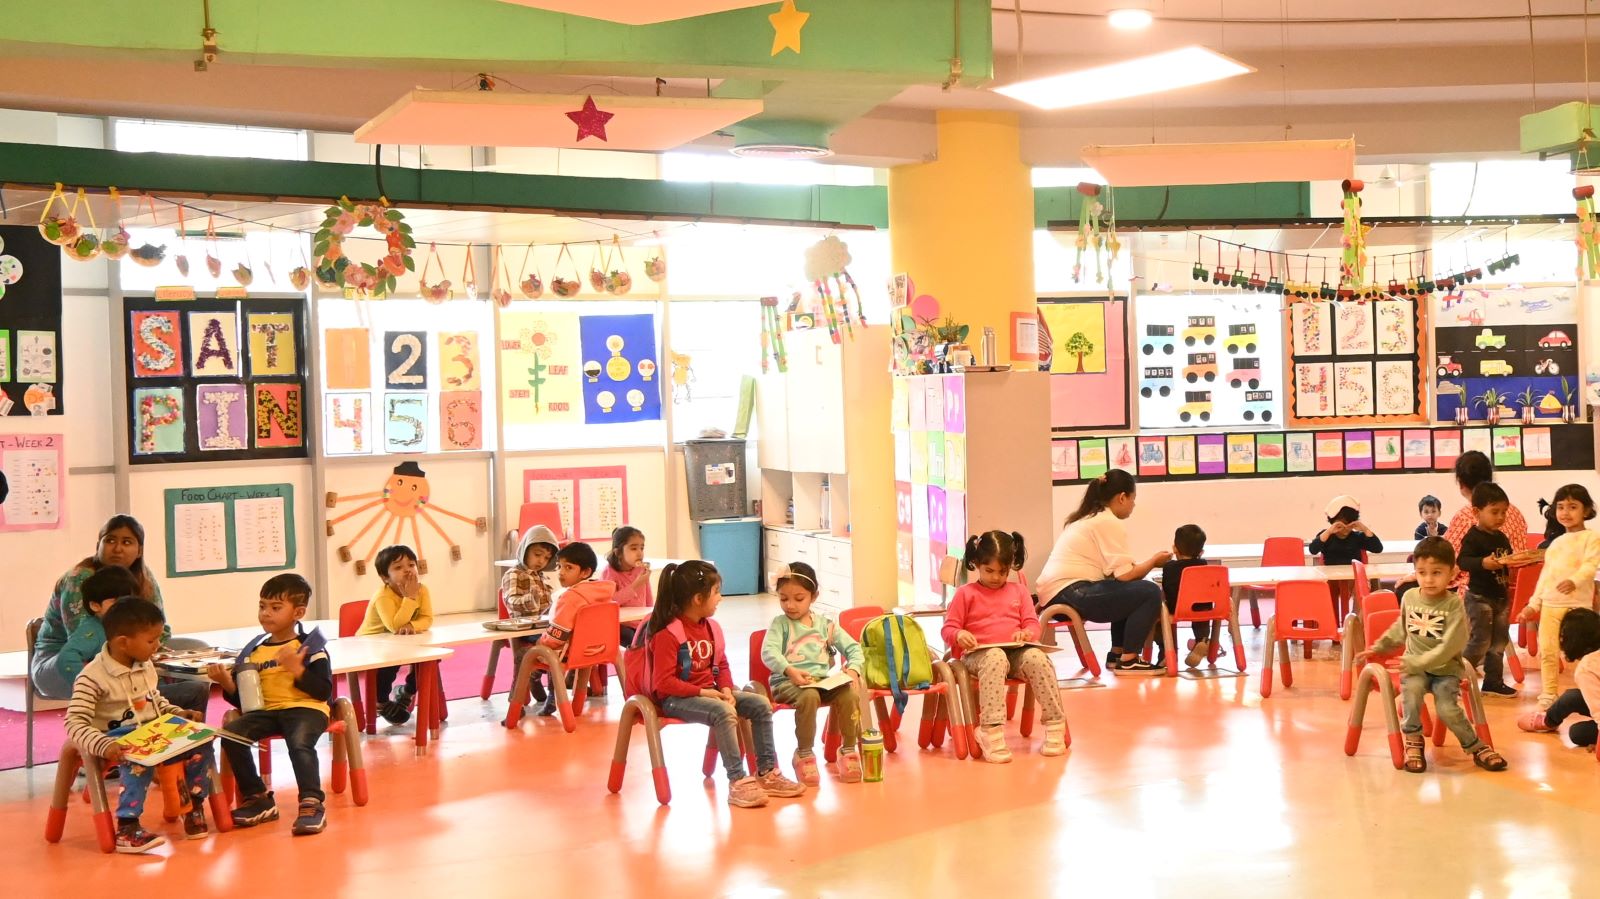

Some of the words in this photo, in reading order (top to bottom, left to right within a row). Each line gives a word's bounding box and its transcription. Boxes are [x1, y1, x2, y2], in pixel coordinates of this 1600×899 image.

[139, 314, 176, 372] S
[196, 318, 235, 370] A
[251, 322, 290, 369] T
[1303, 305, 1321, 352] 1
[1340, 306, 1369, 350] 2
[1381, 304, 1408, 352] 3
[388, 333, 424, 385] 2
[445, 334, 474, 387] 3
[1298, 365, 1327, 411] 4
[1339, 366, 1369, 413] 5
[1383, 365, 1408, 411] 6
[15, 436, 43, 448] WEEK
[45, 436, 54, 447] 2
[140, 393, 181, 451] P
[203, 391, 240, 449] I
[257, 390, 299, 440] N
[333, 397, 363, 452] 4
[388, 398, 425, 447] 5
[447, 399, 478, 448] 6
[181, 489, 205, 501] FOOD
[207, 488, 238, 501] CHART
[274, 488, 281, 498] 1
